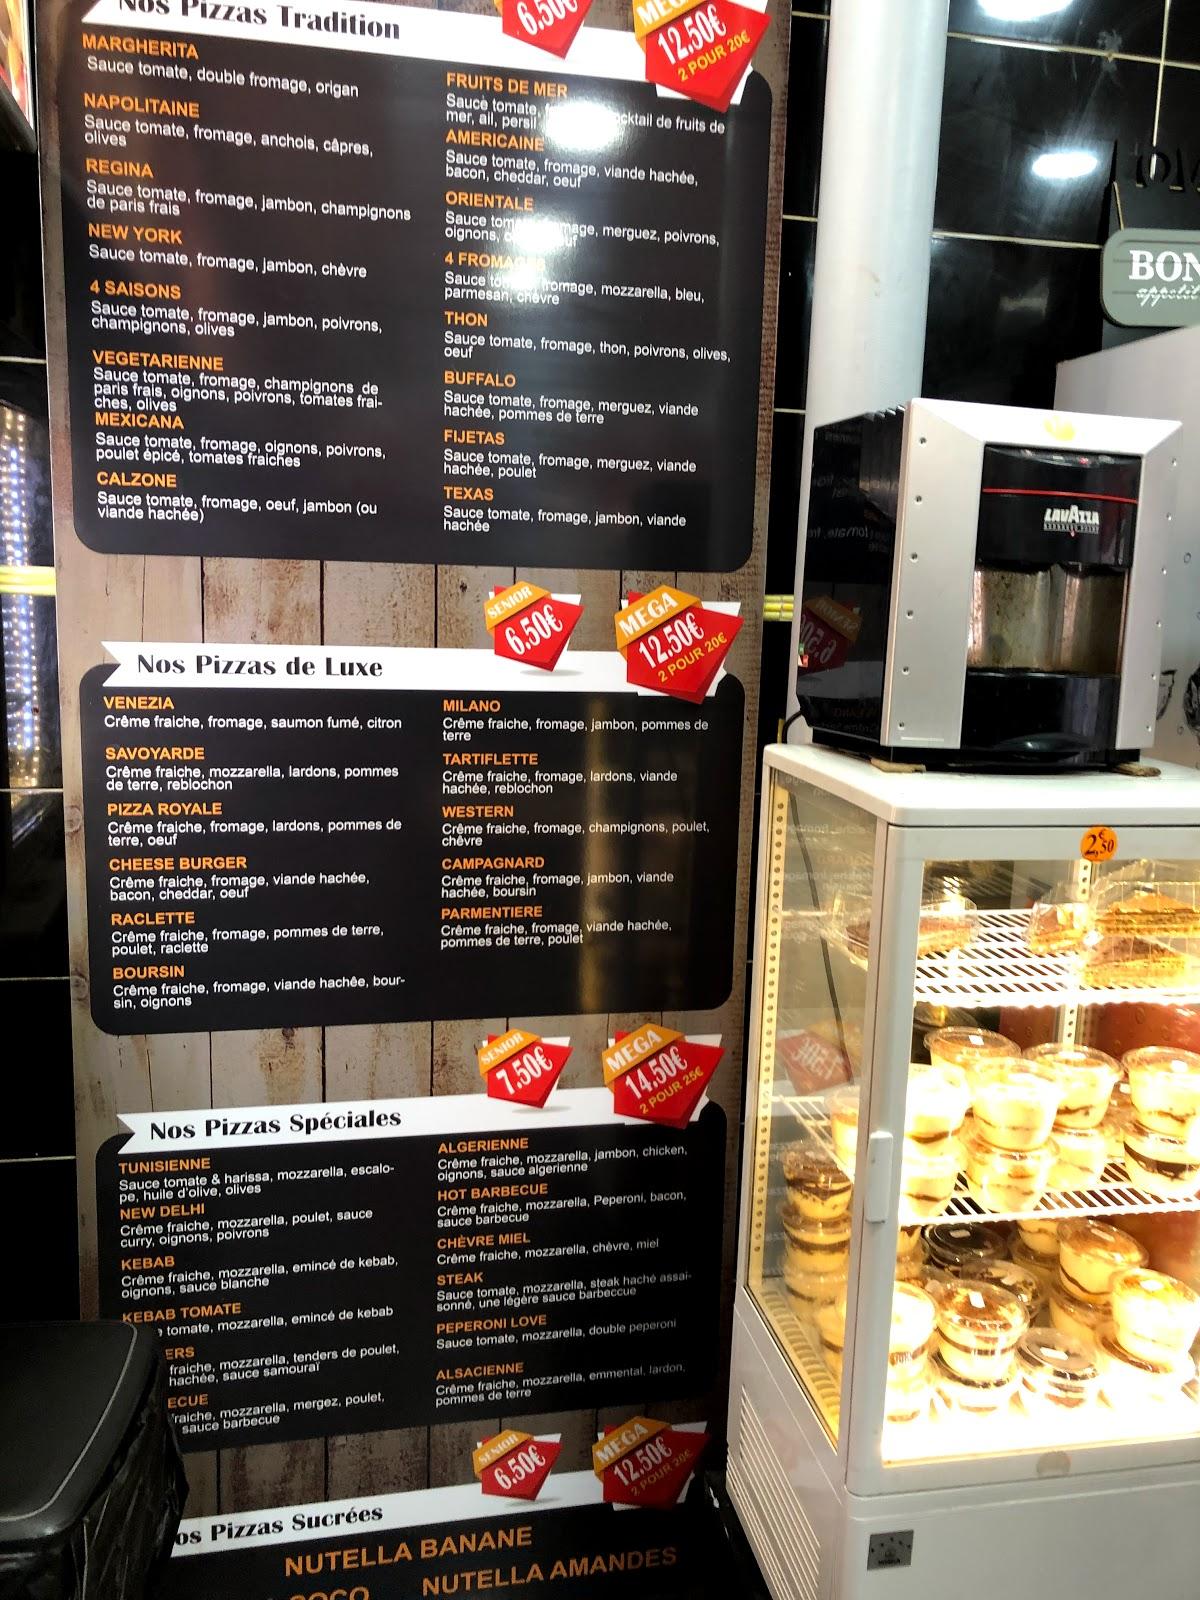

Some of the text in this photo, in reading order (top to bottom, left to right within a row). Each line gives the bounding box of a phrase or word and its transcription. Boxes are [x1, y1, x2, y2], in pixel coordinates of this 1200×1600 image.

[119, 0, 400, 39] Nos Pizzas Tradition
[658, 5, 727, 65] 12.50€
[82, 34, 198, 58] MARGHERITA
[678, 30, 750, 82] 2 POUR 20€
[87, 56, 358, 98] Sauce tomate, double fromage, origan
[446, 72, 567, 98] FRUITS DE MER
[83, 93, 199, 117] NAPOLITAINE
[445, 129, 544, 151] AMERICAINE
[85, 159, 154, 177] REGINA
[445, 191, 533, 210] ORIENTALE
[88, 223, 182, 244] NEW YORK
[88, 244, 135, 261] Sauce
[138, 248, 192, 267] tomate,
[196, 252, 258, 272] fromage,
[261, 257, 316, 276] jambon,
[1128, 250, 1200, 282] BON
[89, 279, 181, 299] 4 SAISONS
[444, 311, 488, 326] THON
[443, 346, 473, 358] oeuf
[444, 331, 730, 363] Sauce tomate, fromage, thon, poivrons, olives,
[92, 350, 223, 370] VEGETARIENNE
[444, 370, 516, 387] BUFFALO
[95, 412, 184, 429] MEXICANA
[443, 429, 504, 445] FIJETAS
[96, 471, 176, 488] CALZONE
[443, 486, 494, 500] TEXAS
[1044, 504, 1100, 525] LAVAZZA
[487, 586, 533, 619] SENIOR
[618, 592, 679, 638] MEGA
[505, 604, 563, 656] 6.50€
[638, 612, 705, 669] 12.50€
[138, 654, 383, 677] Nos Pizzas de Luxe
[658, 632, 728, 683] 2 POUR 20€
[102, 696, 174, 709] VENEZIA
[442, 699, 500, 712] MILANO
[207, 715, 266, 731] fromage,
[270, 718, 323, 728] saumon
[326, 715, 362, 730] fumé,
[366, 715, 402, 728] citron
[535, 716, 587, 732] fromage,
[590, 717, 637, 732] jambon,
[641, 720, 690, 732] pommes
[693, 717, 708, 730] de
[442, 730, 471, 741] terre
[105, 747, 204, 760] SAVOYARDE
[442, 752, 538, 765] TARTIFLETTE
[208, 764, 284, 779] mozzarella,
[288, 764, 340, 779] lardons,
[344, 767, 398, 780] pommes
[105, 778, 232, 792] de terre, reblochon
[107, 802, 222, 816] PIZZA ROYALE
[441, 804, 514, 818] WESTERN
[108, 856, 247, 871] CHEESE BURGER
[441, 855, 544, 869] CAMPAGNARD
[110, 911, 195, 925] RACLETTE
[441, 905, 542, 919] PARMENTIERE
[112, 964, 184, 979] BOURSIN
[480, 1032, 524, 1063] SENIOR
[606, 1029, 662, 1072] MEGA
[496, 1045, 553, 1095] 7.50€
[625, 1045, 688, 1100] 14.50€
[640, 1066, 704, 1114] 2 POUR 25€
[150, 1110, 402, 1140] Nos Pizzas Spéciales
[437, 1136, 528, 1154] ALGERIENNE
[118, 1156, 210, 1174] TUNISIENNE
[437, 1181, 548, 1200] HOT BARBECUE
[119, 1201, 204, 1219] NEW DELHI
[217, 1214, 288, 1229] mozzarella,
[292, 1210, 332, 1226] poulet,
[336, 1209, 373, 1220] sauce
[120, 1228, 269, 1248] curry, oignons, poivrons
[498, 1230, 530, 1245] MIEL
[524, 1243, 588, 1258] mozzarella,
[636, 1236, 658, 1249] miel
[121, 1254, 174, 1270] KEBAB
[436, 1270, 483, 1286] STEAK
[122, 1301, 241, 1323] KEBAB TOMATE
[436, 1314, 546, 1334] PEPERONI LOVE
[435, 1361, 523, 1380] ALSACIENNE
[478, 1433, 519, 1463] SENIOR
[595, 1423, 649, 1463] MEGA
[494, 1444, 546, 1491] 6.50€
[613, 1436, 673, 1487] 12.50€
[640, 1466, 672, 1490] POUR
[210, 1519, 284, 1542] Pizzas
[292, 1506, 384, 1532] Sucrées
[285, 1526, 533, 1577] NUTELLA BANANE
[422, 1547, 678, 1597] NUTELLA AMANDES
